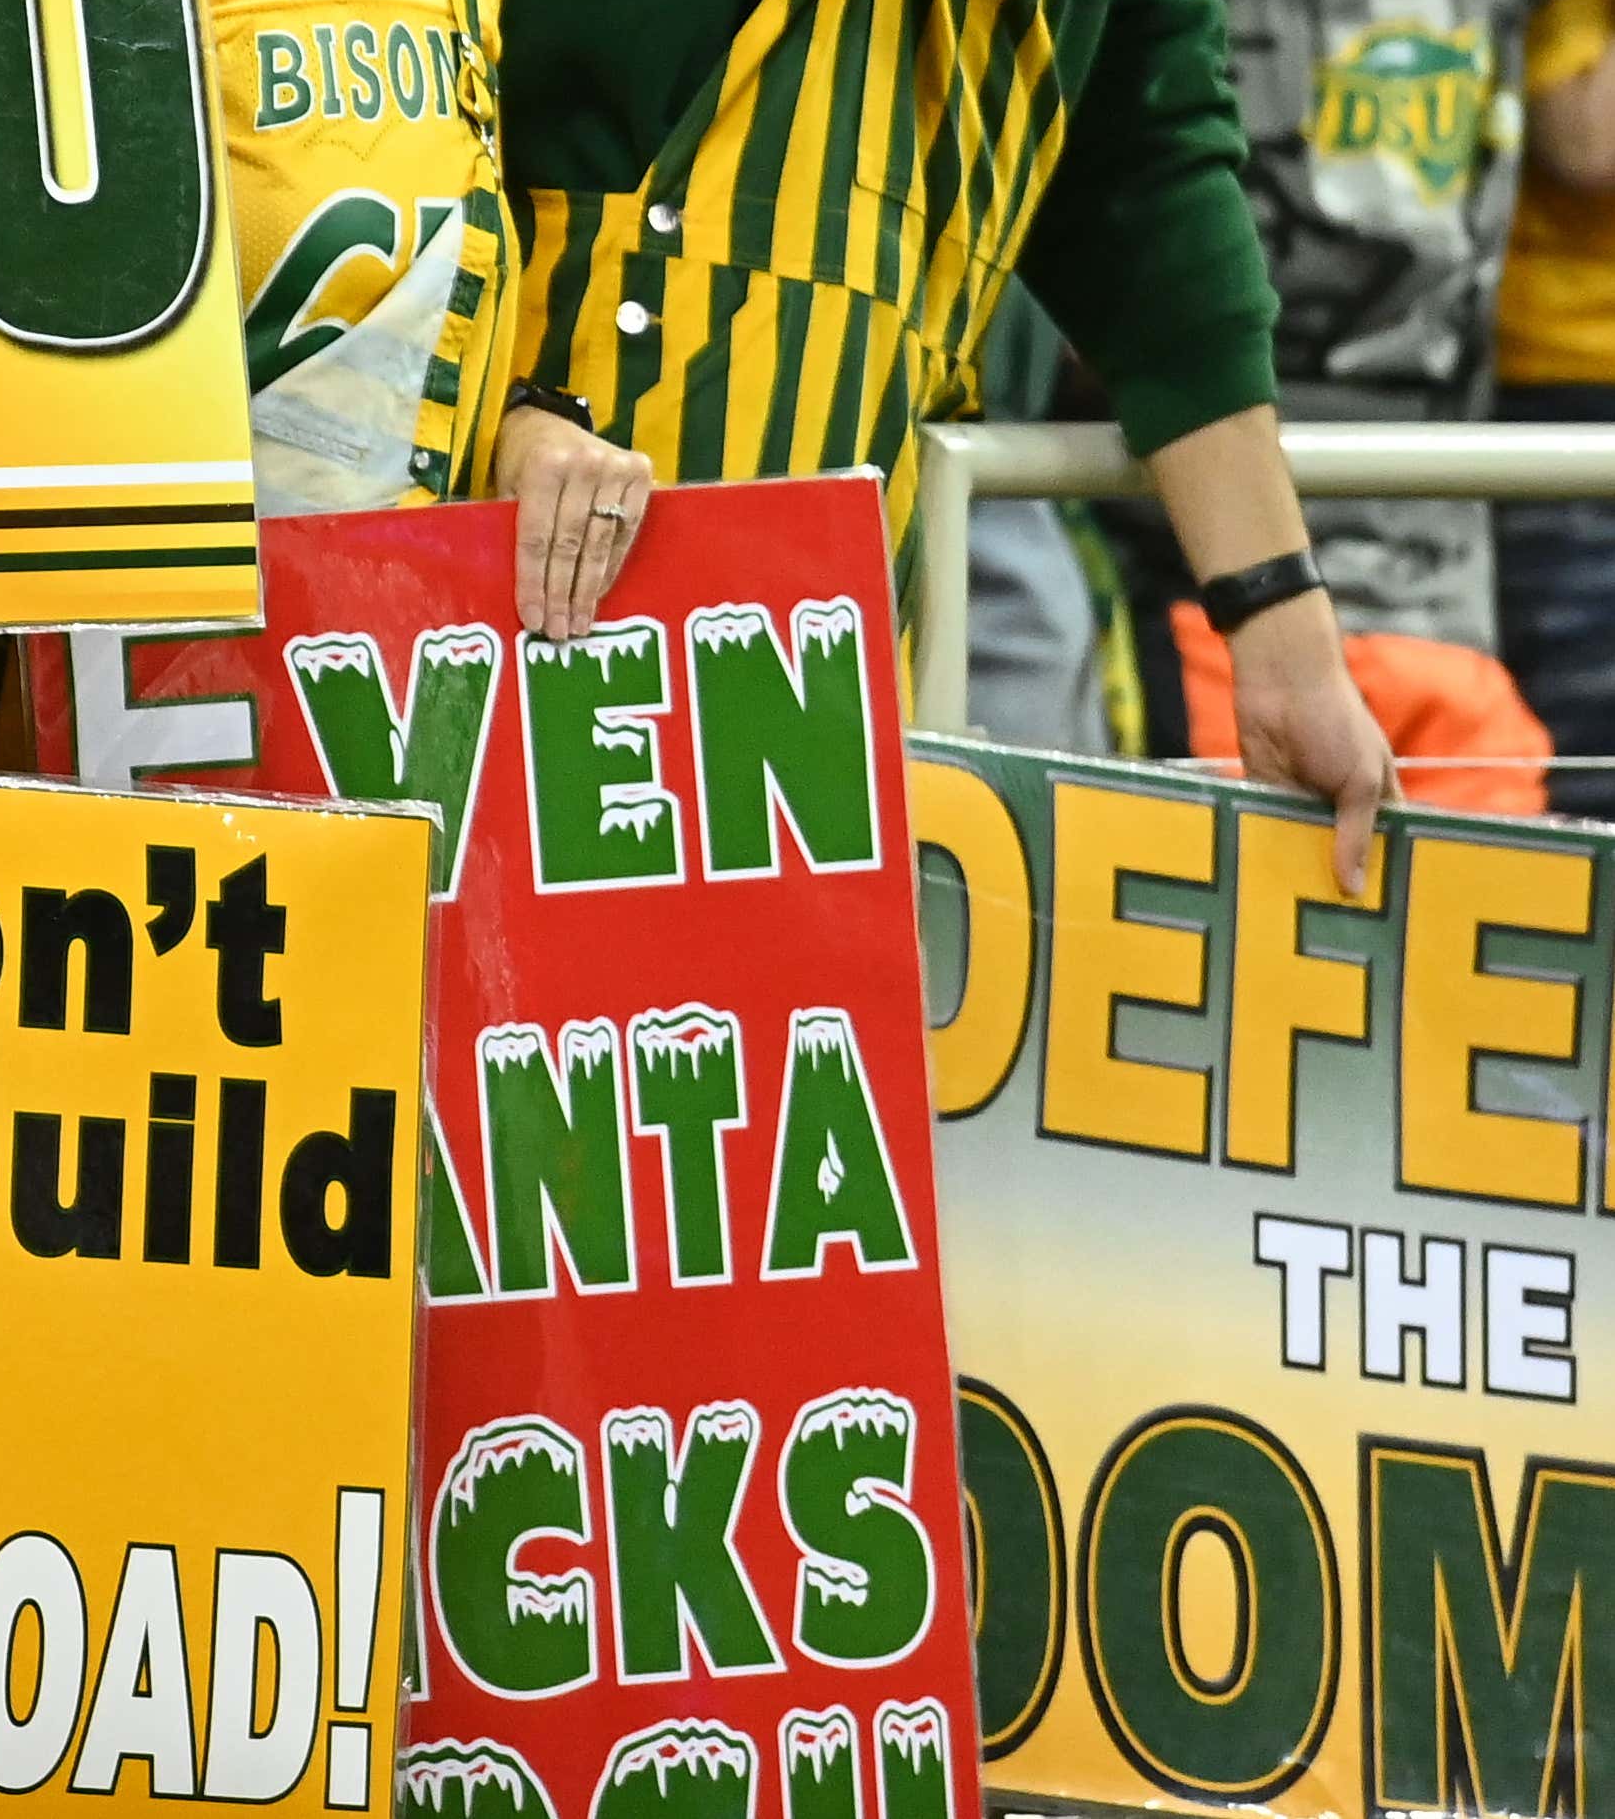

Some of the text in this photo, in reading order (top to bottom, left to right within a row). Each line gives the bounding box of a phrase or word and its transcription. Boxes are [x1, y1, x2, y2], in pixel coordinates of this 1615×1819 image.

[253, 19, 469, 131] BISON
[1316, 74, 1477, 155] DSU
[907, 754, 1615, 1219] DEFE
[1253, 1211, 1579, 1404] THE
[411, 1387, 935, 1701] CKS
